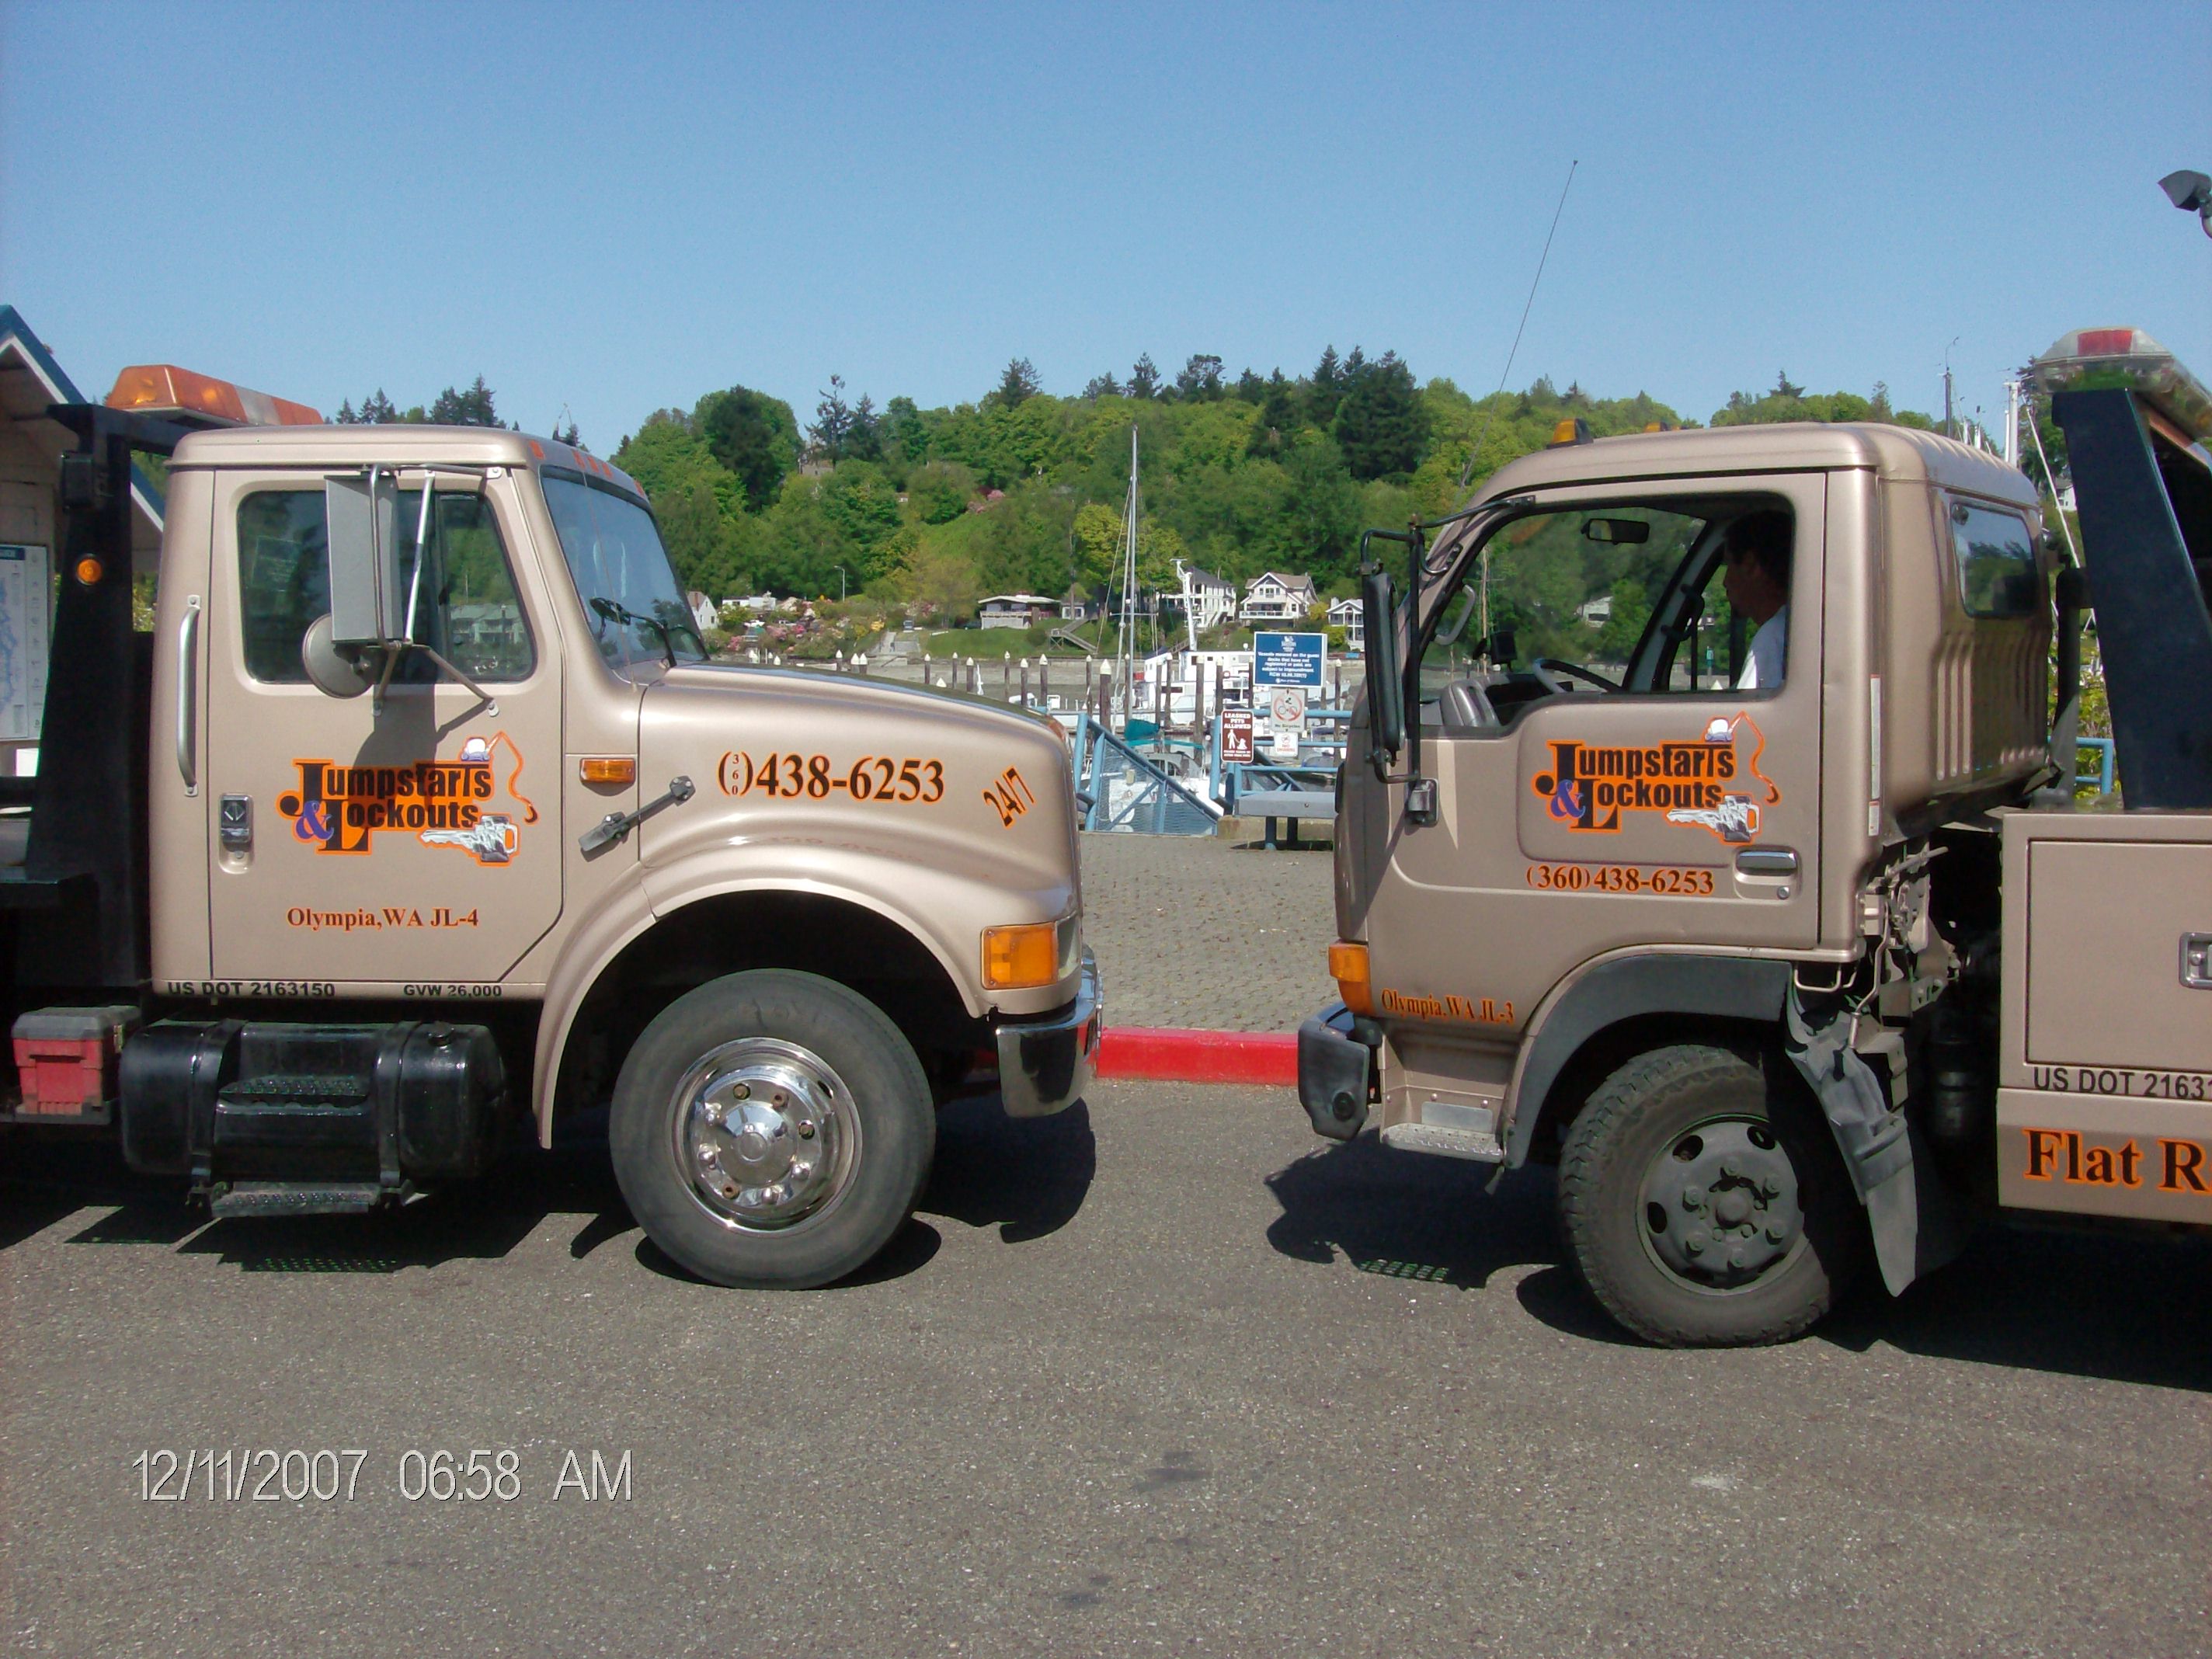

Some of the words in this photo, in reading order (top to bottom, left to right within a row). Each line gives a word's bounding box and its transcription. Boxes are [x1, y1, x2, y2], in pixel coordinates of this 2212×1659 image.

[982, 767, 1035, 827] 24/7
[1525, 864, 1713, 894] (360)438-6253
[430, 908, 479, 927] JL-4
[167, 982, 194, 995] US
[201, 982, 243, 995] DOT
[250, 983, 335, 996] 2163150
[403, 984, 442, 996] GVW
[447, 985, 502, 998] 26,000
[2033, 1066, 2069, 1091] US
[2078, 1069, 2135, 1095] DOT
[2022, 1129, 2143, 1186] Flat
